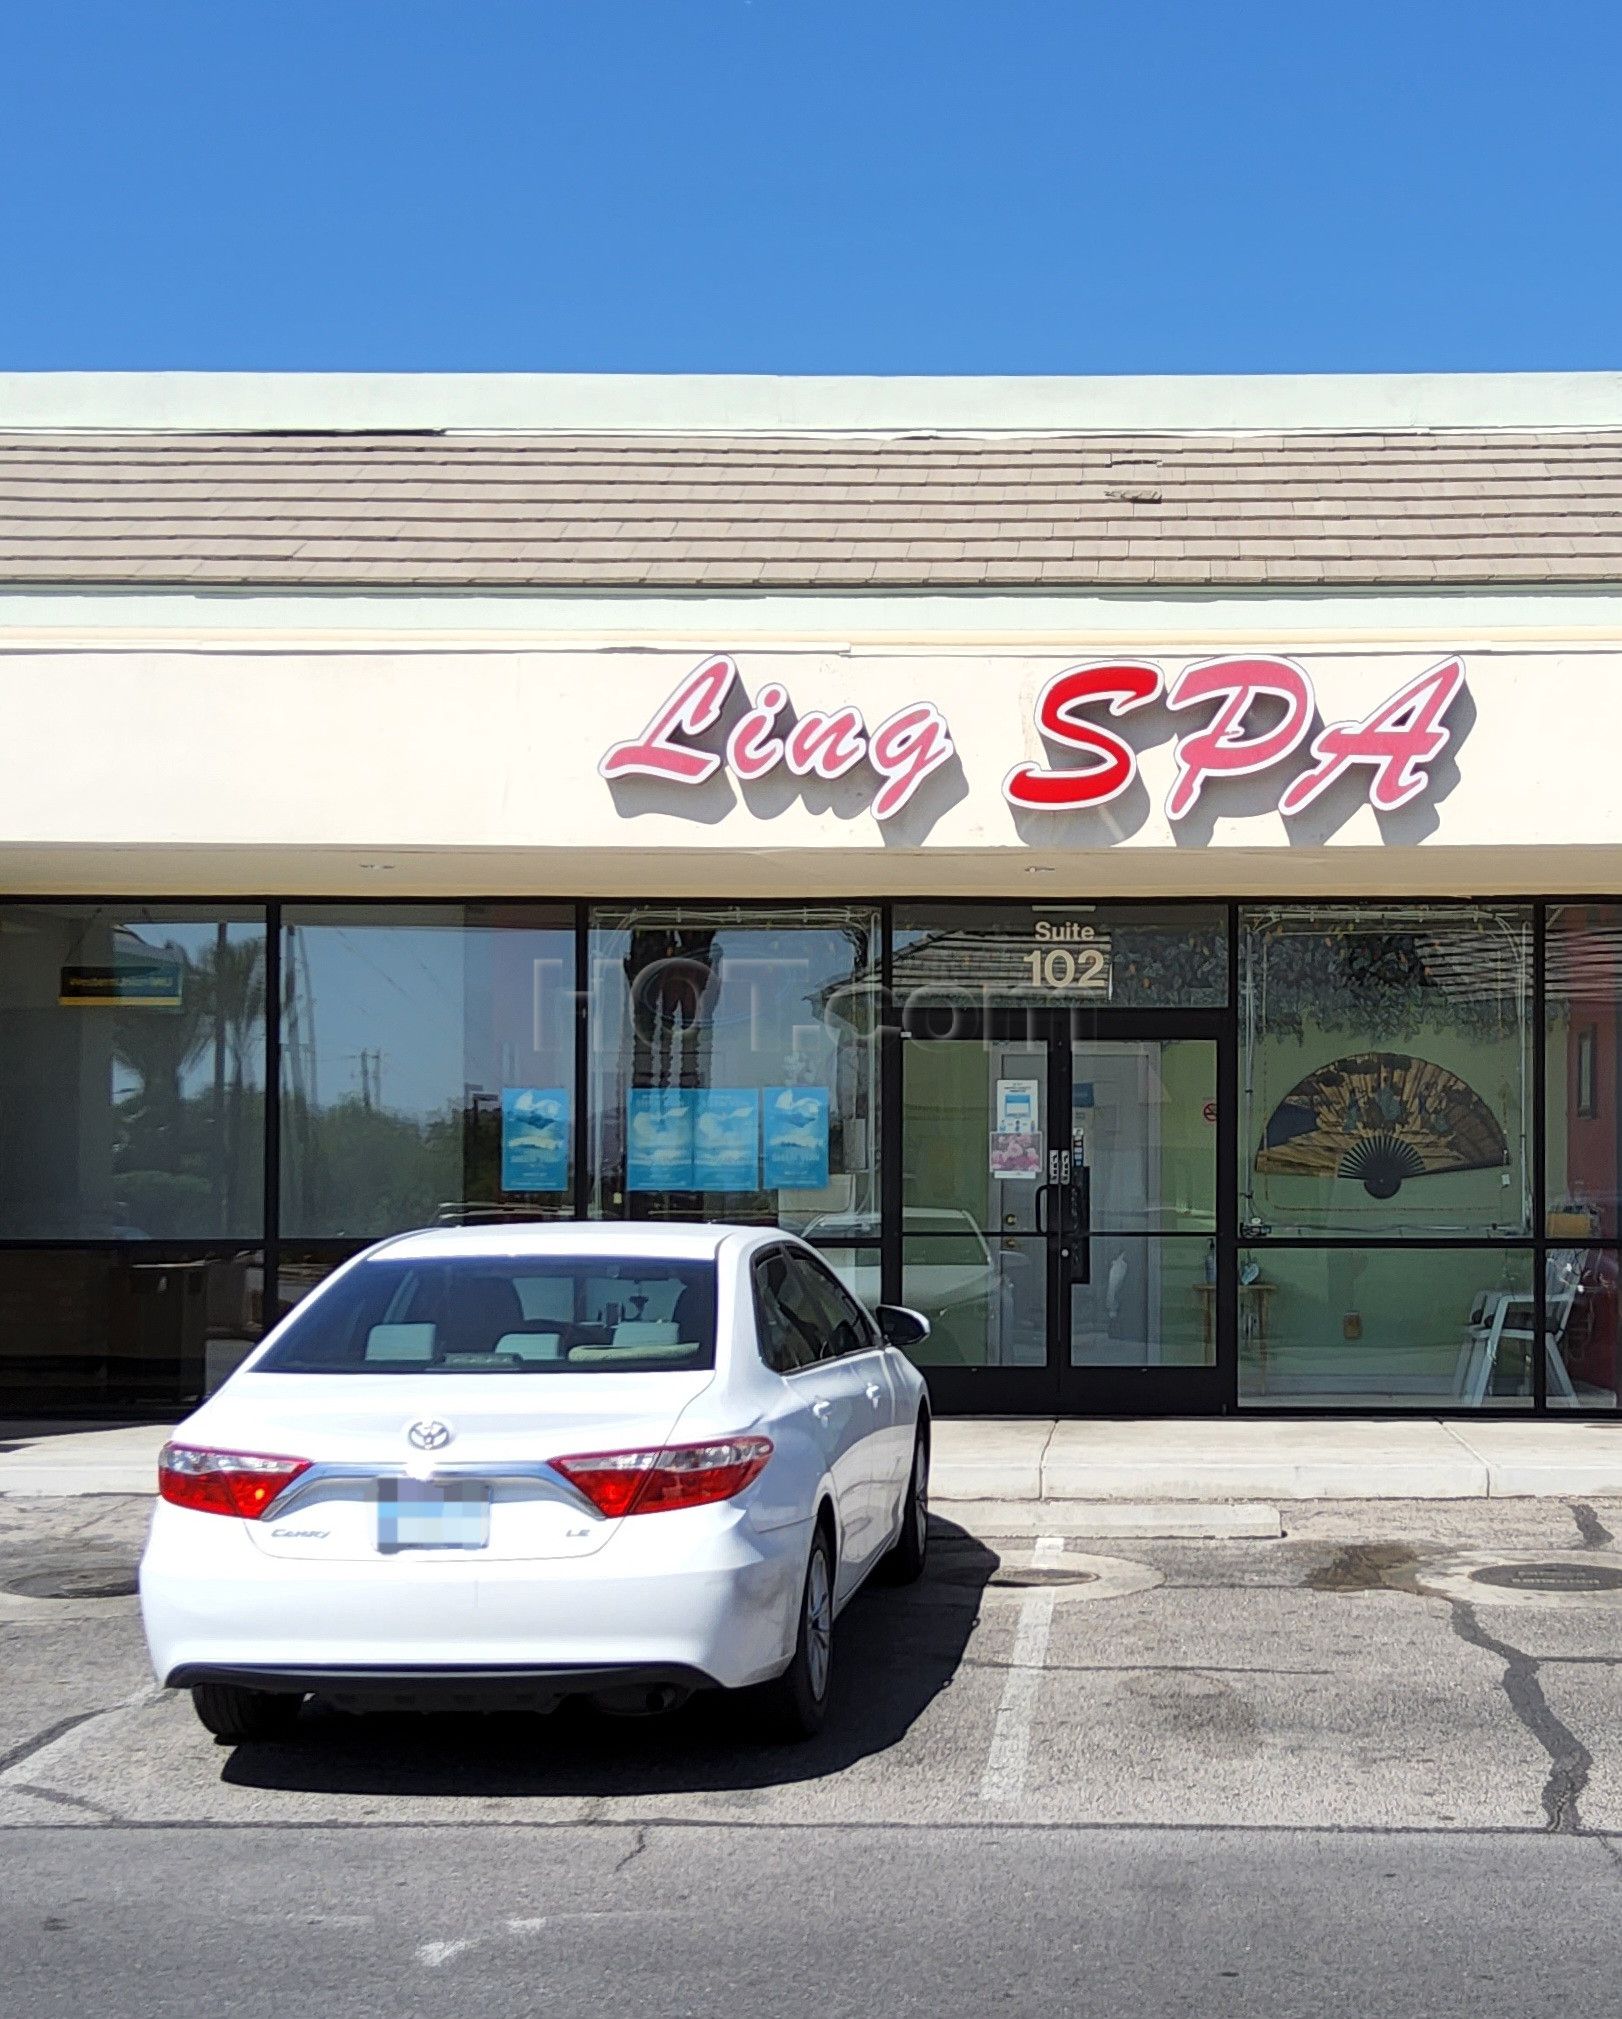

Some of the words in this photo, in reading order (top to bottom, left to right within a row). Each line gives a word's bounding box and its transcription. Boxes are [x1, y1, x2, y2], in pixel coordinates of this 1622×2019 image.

[600, 655, 955, 821] Ling
[1003, 655, 1465, 820] SPA
[1034, 921, 1095, 940] Suite
[1023, 949, 1105, 987] 102
